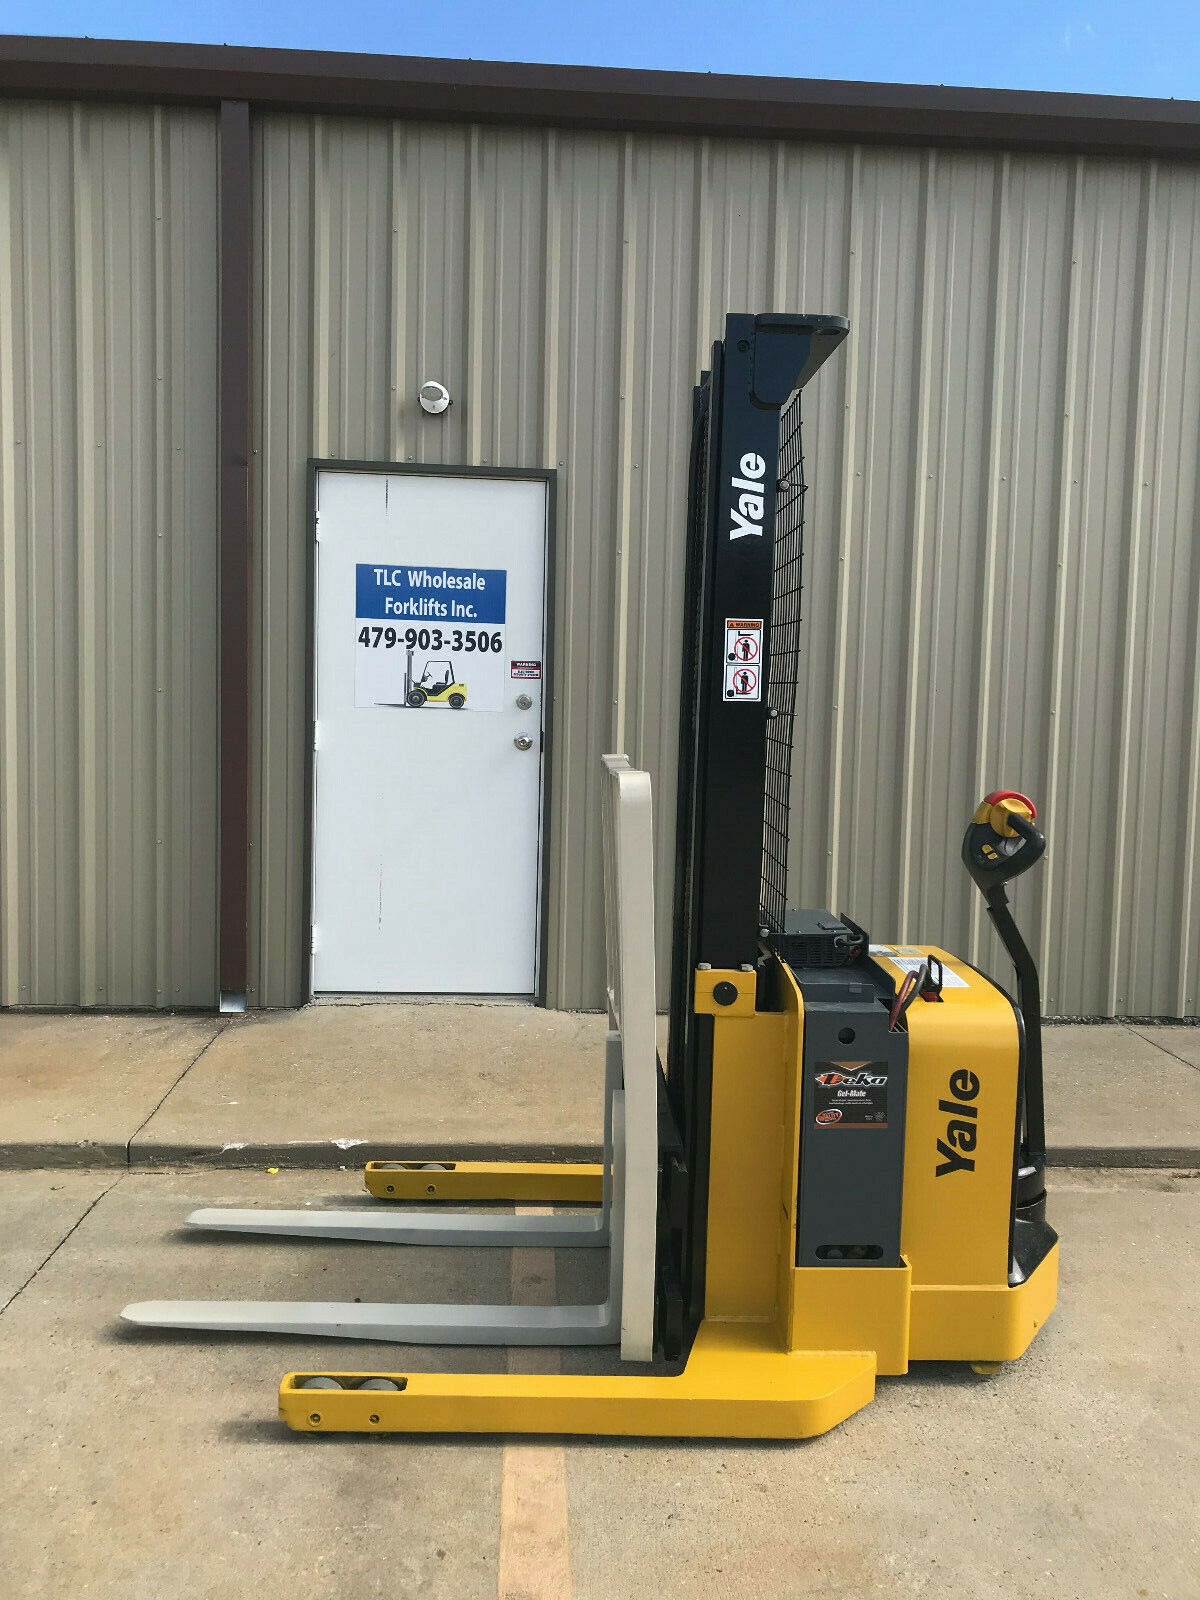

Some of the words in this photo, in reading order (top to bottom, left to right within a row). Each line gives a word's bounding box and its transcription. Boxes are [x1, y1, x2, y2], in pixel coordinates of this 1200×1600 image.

[729, 452, 766, 541] Yale
[373, 568, 402, 586] TLC
[407, 570, 486, 590] Wholesale
[385, 597, 448, 617] Forklifts
[451, 599, 478, 618] Inc.
[358, 626, 503, 653] 479-903-3506
[815, 1072, 888, 1087] Deka
[837, 1089, 867, 1097] Gel-Mate
[935, 1068, 980, 1178] Yale
